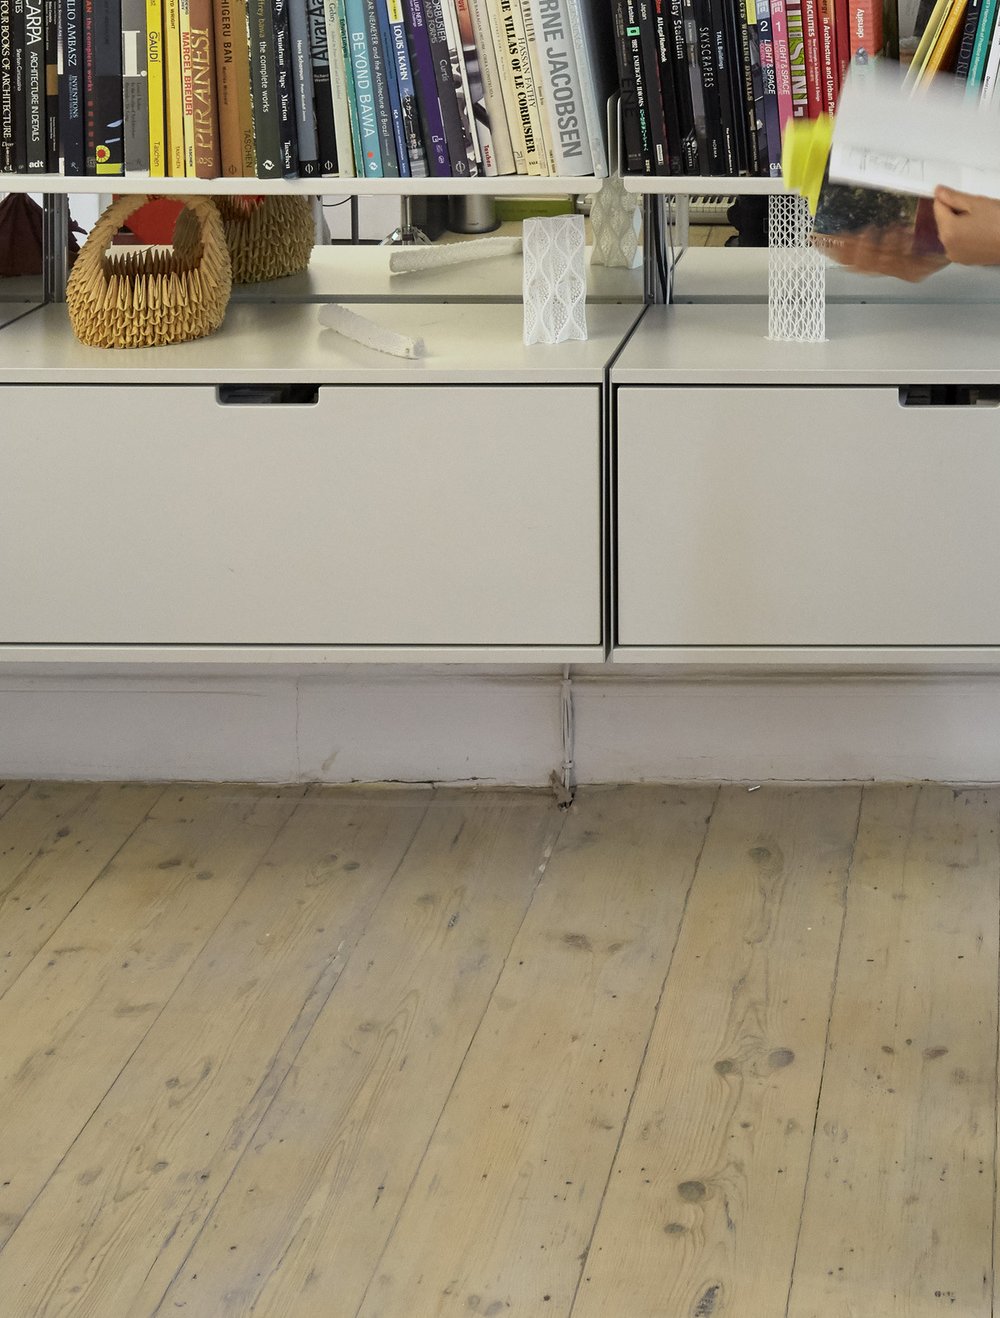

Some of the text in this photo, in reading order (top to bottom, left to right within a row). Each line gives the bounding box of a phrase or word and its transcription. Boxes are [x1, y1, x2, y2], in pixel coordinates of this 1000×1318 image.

[68, 24, 77, 66] AMBASZ
[223, 42, 232, 63] BAN
[503, 17, 519, 55] VILLAS
[672, 20, 684, 59] Stadium
[31, 52, 39, 104] ARCHITECTURE
[182, 32, 193, 116] MARCEL BREUER
[352, 32, 375, 137] BEYOND BAWA
[511, 59, 522, 72] OF
[514, 75, 524, 89] LE
[514, 92, 535, 153] CORBUSIER
[546, 47, 583, 158] JACOBSEN
